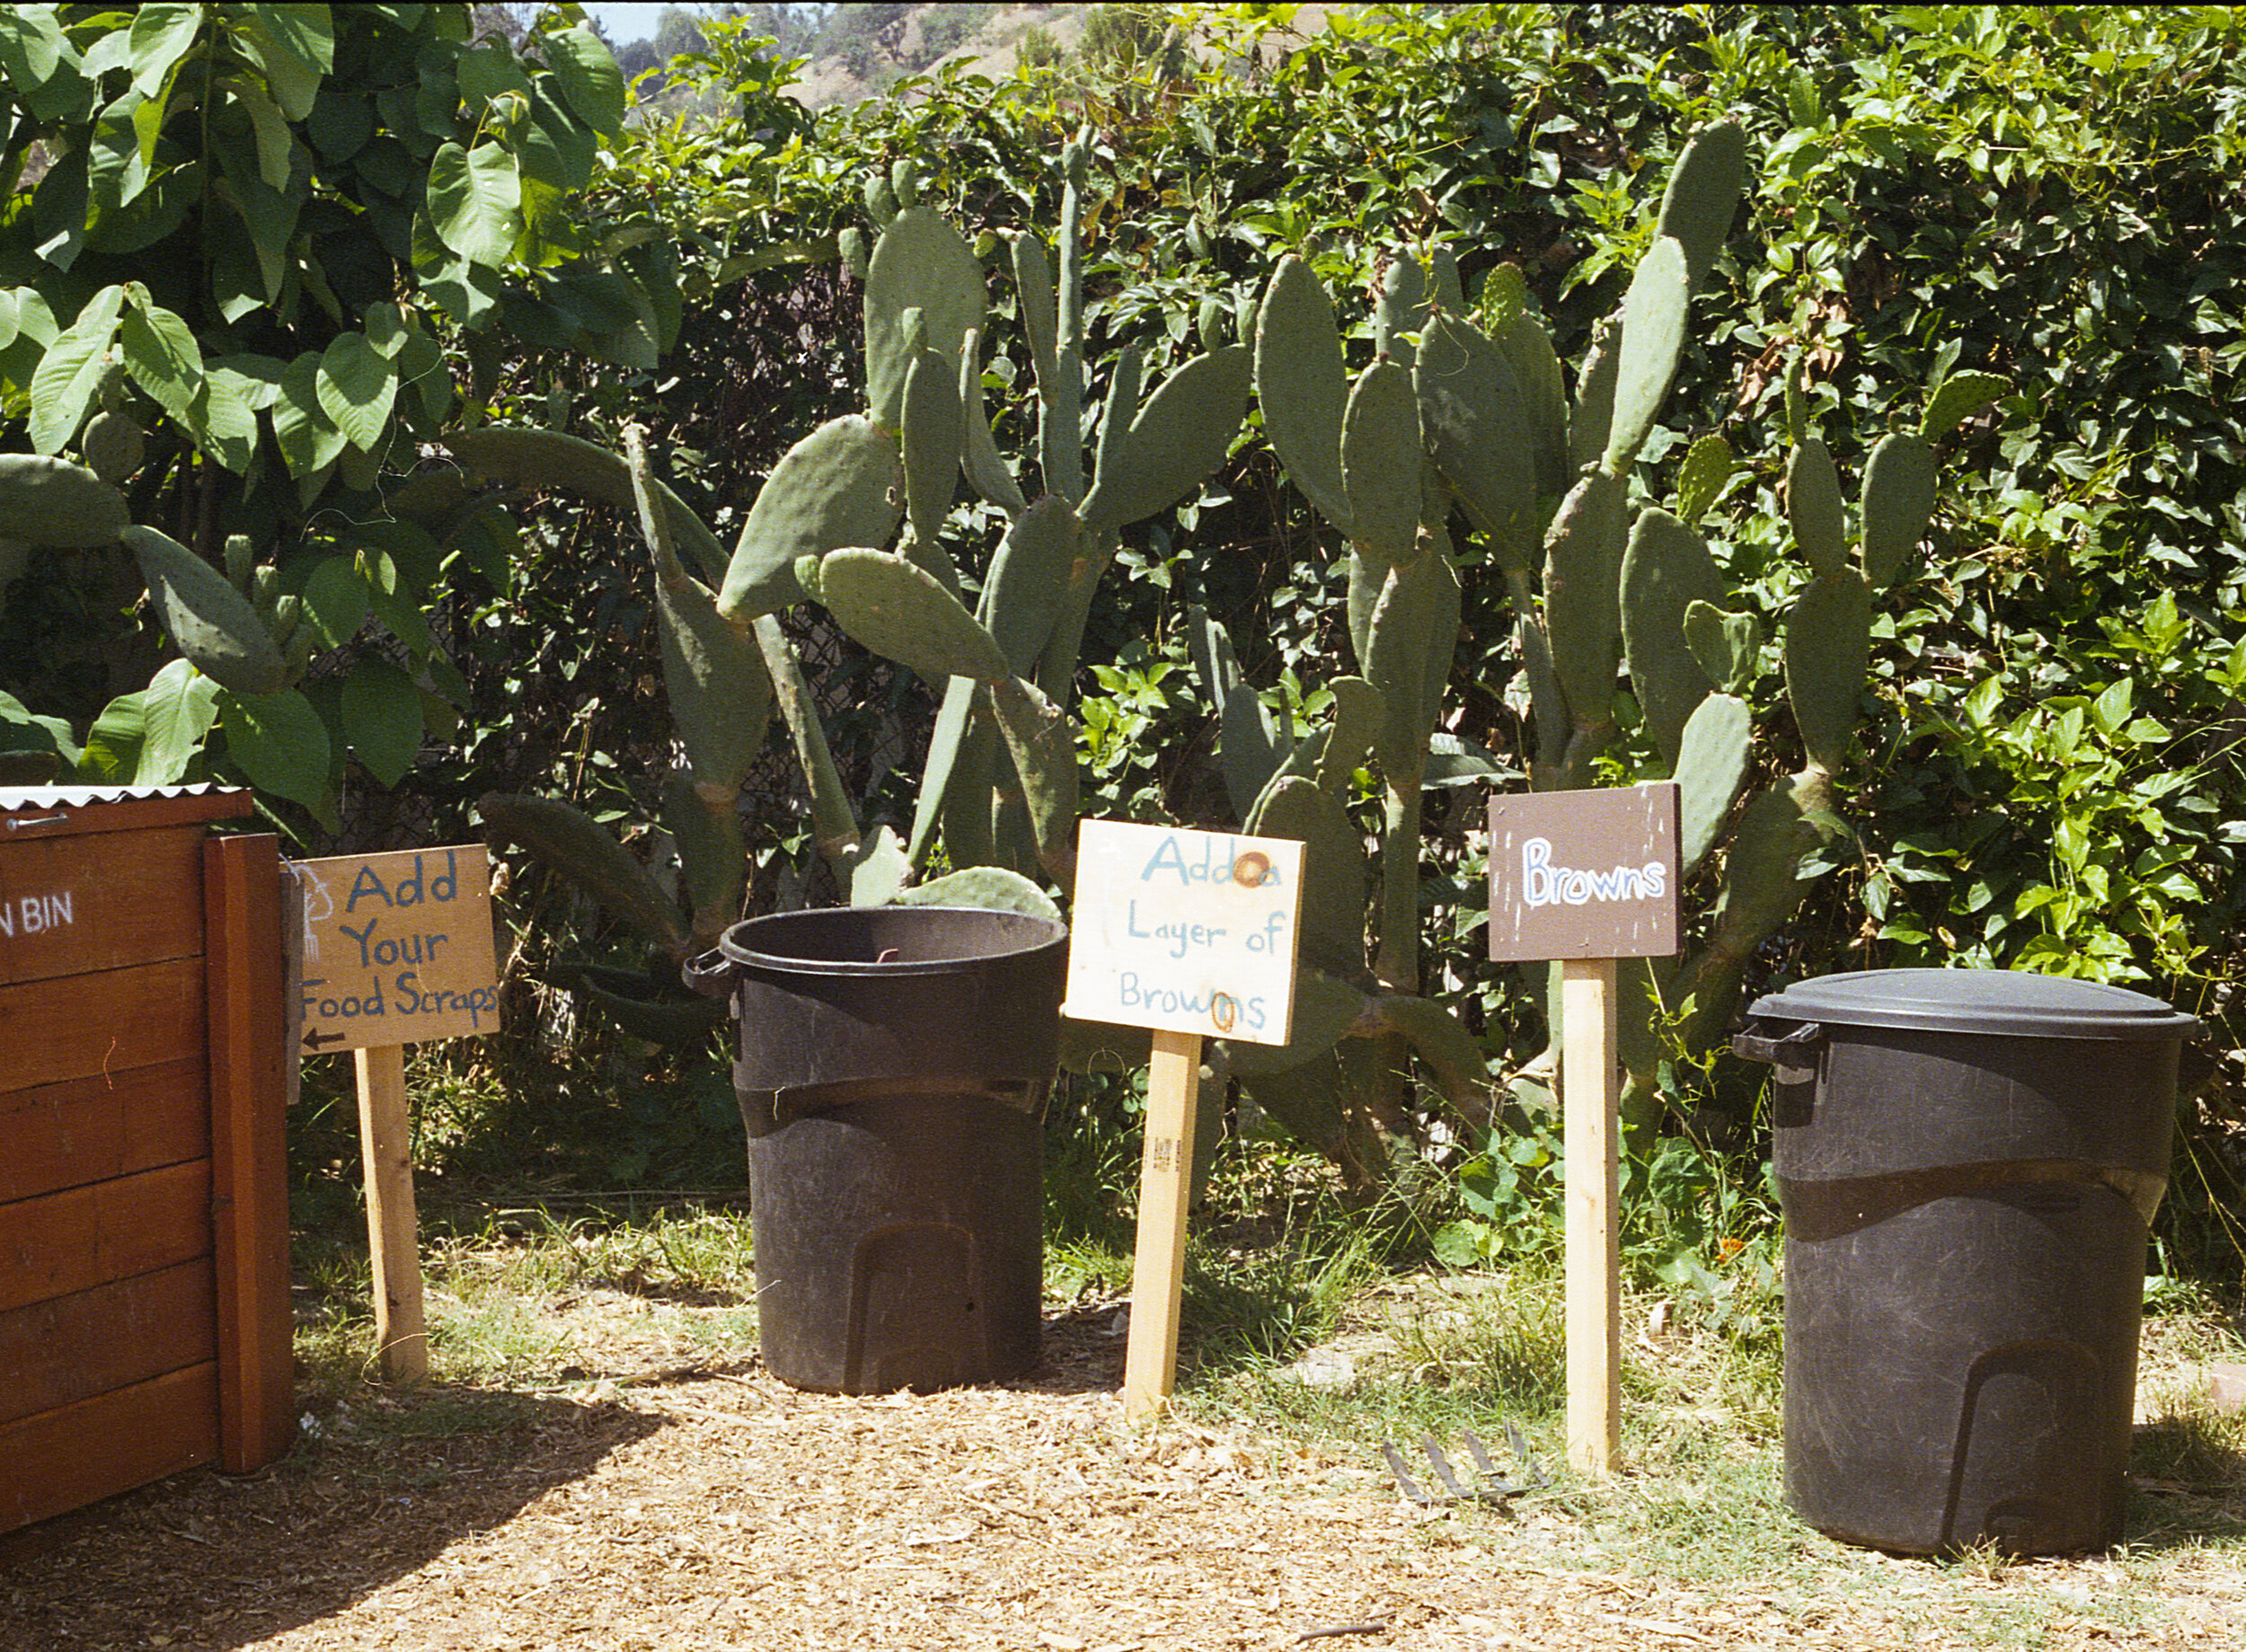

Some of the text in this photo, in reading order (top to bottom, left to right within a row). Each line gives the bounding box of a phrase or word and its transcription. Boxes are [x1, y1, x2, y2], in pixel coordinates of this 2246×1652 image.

[346, 850, 457, 913] Add
[1141, 835, 1282, 887] Add a
[1522, 836, 1667, 906] Browns
[21, 891, 73, 933] BIN
[1128, 899, 1287, 959] Layer of
[339, 918, 448, 968] Your
[301, 972, 498, 1029] Food Scraps
[1121, 972, 1266, 1030] Browns
